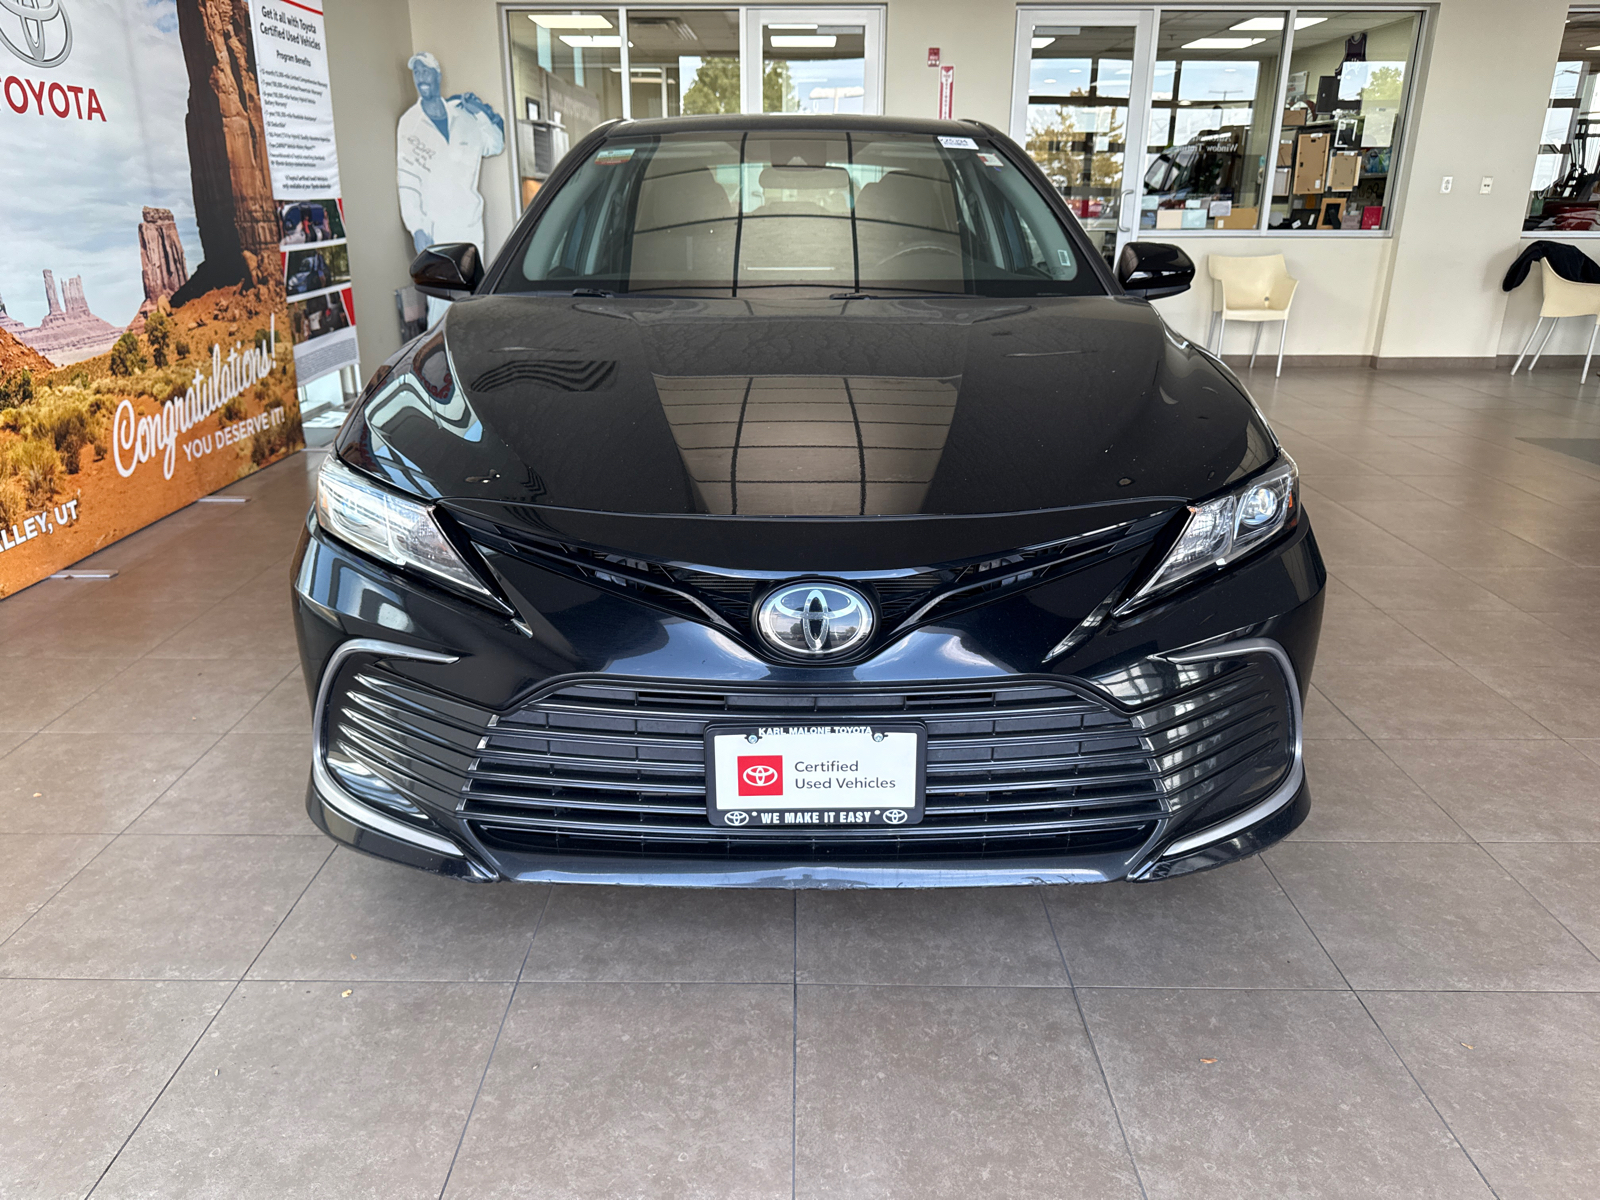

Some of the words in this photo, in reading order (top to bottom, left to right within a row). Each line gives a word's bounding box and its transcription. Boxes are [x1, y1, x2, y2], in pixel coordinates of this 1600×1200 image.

[261, 5, 273, 20] Get
[273, 9, 279, 21] it
[279, 11, 287, 24] all
[287, 15, 299, 29] with
[299, 18, 316, 34] Toyota
[260, 22, 285, 40] Certified
[286, 29, 299, 44] Used
[300, 33, 321, 50] Vehicles
[276, 49, 294, 63] Program
[294, 54, 311, 67] Benefits
[0, 75, 107, 122] OYOTA
[113, 313, 277, 481] Congratulations!
[183, 434, 212, 462] YOU
[215, 413, 270, 449] DESERVE
[270, 406, 285, 428] IT!
[54, 499, 77, 525] UT
[758, 727, 786, 736] KARL
[788, 727, 831, 736] MALONE
[833, 726, 872, 735] TOYOTA
[794, 760, 859, 773] Certified
[795, 777, 832, 789] Used
[836, 776, 896, 789] Vehicles
[760, 812, 780, 824] WE
[784, 812, 820, 823] MAKE
[823, 811, 835, 823] IT
[839, 811, 871, 823] EASY
